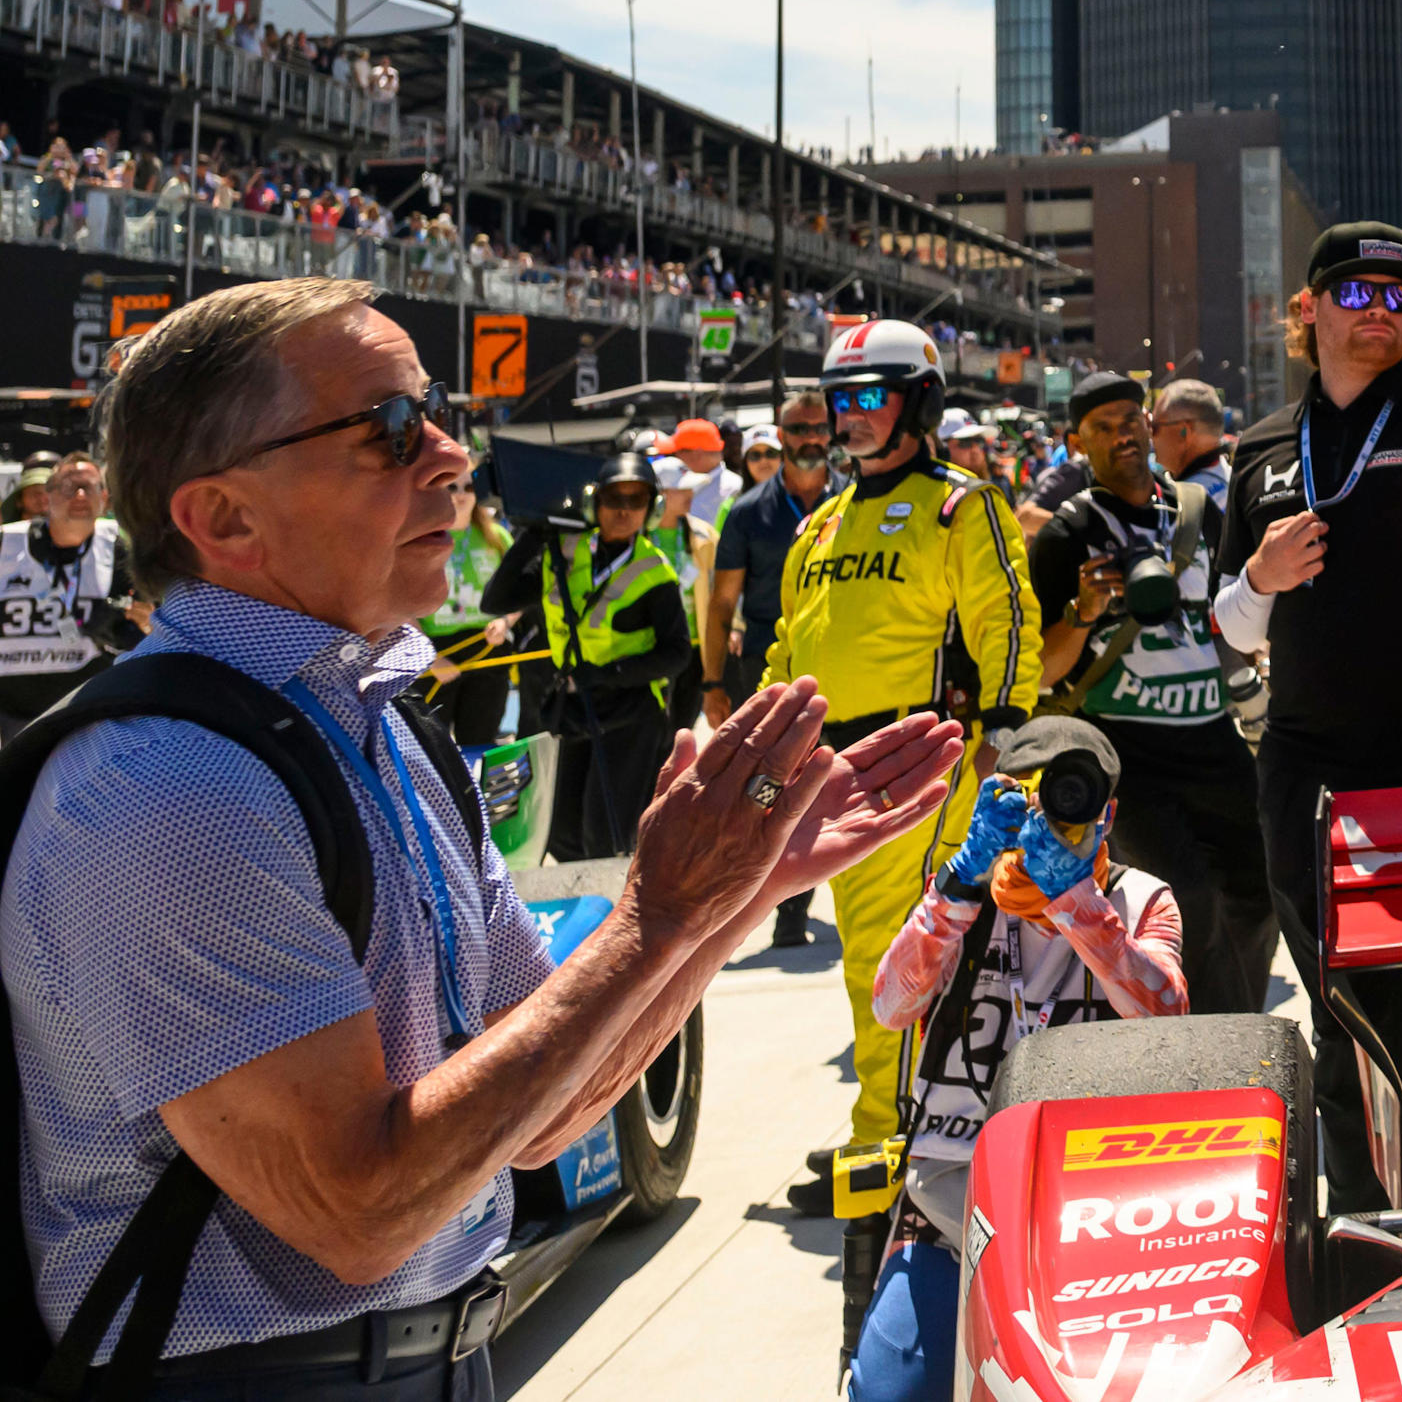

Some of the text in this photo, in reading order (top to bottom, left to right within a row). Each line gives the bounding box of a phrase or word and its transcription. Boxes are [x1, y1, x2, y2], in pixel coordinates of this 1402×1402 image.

[797, 551, 905, 594] FFICIAL
[1092, 1124, 1254, 1163] DHL
[1139, 1226, 1267, 1252] Insurance
[1052, 1256, 1261, 1303] SUNOCO
[1058, 1293, 1243, 1338] SOLO
